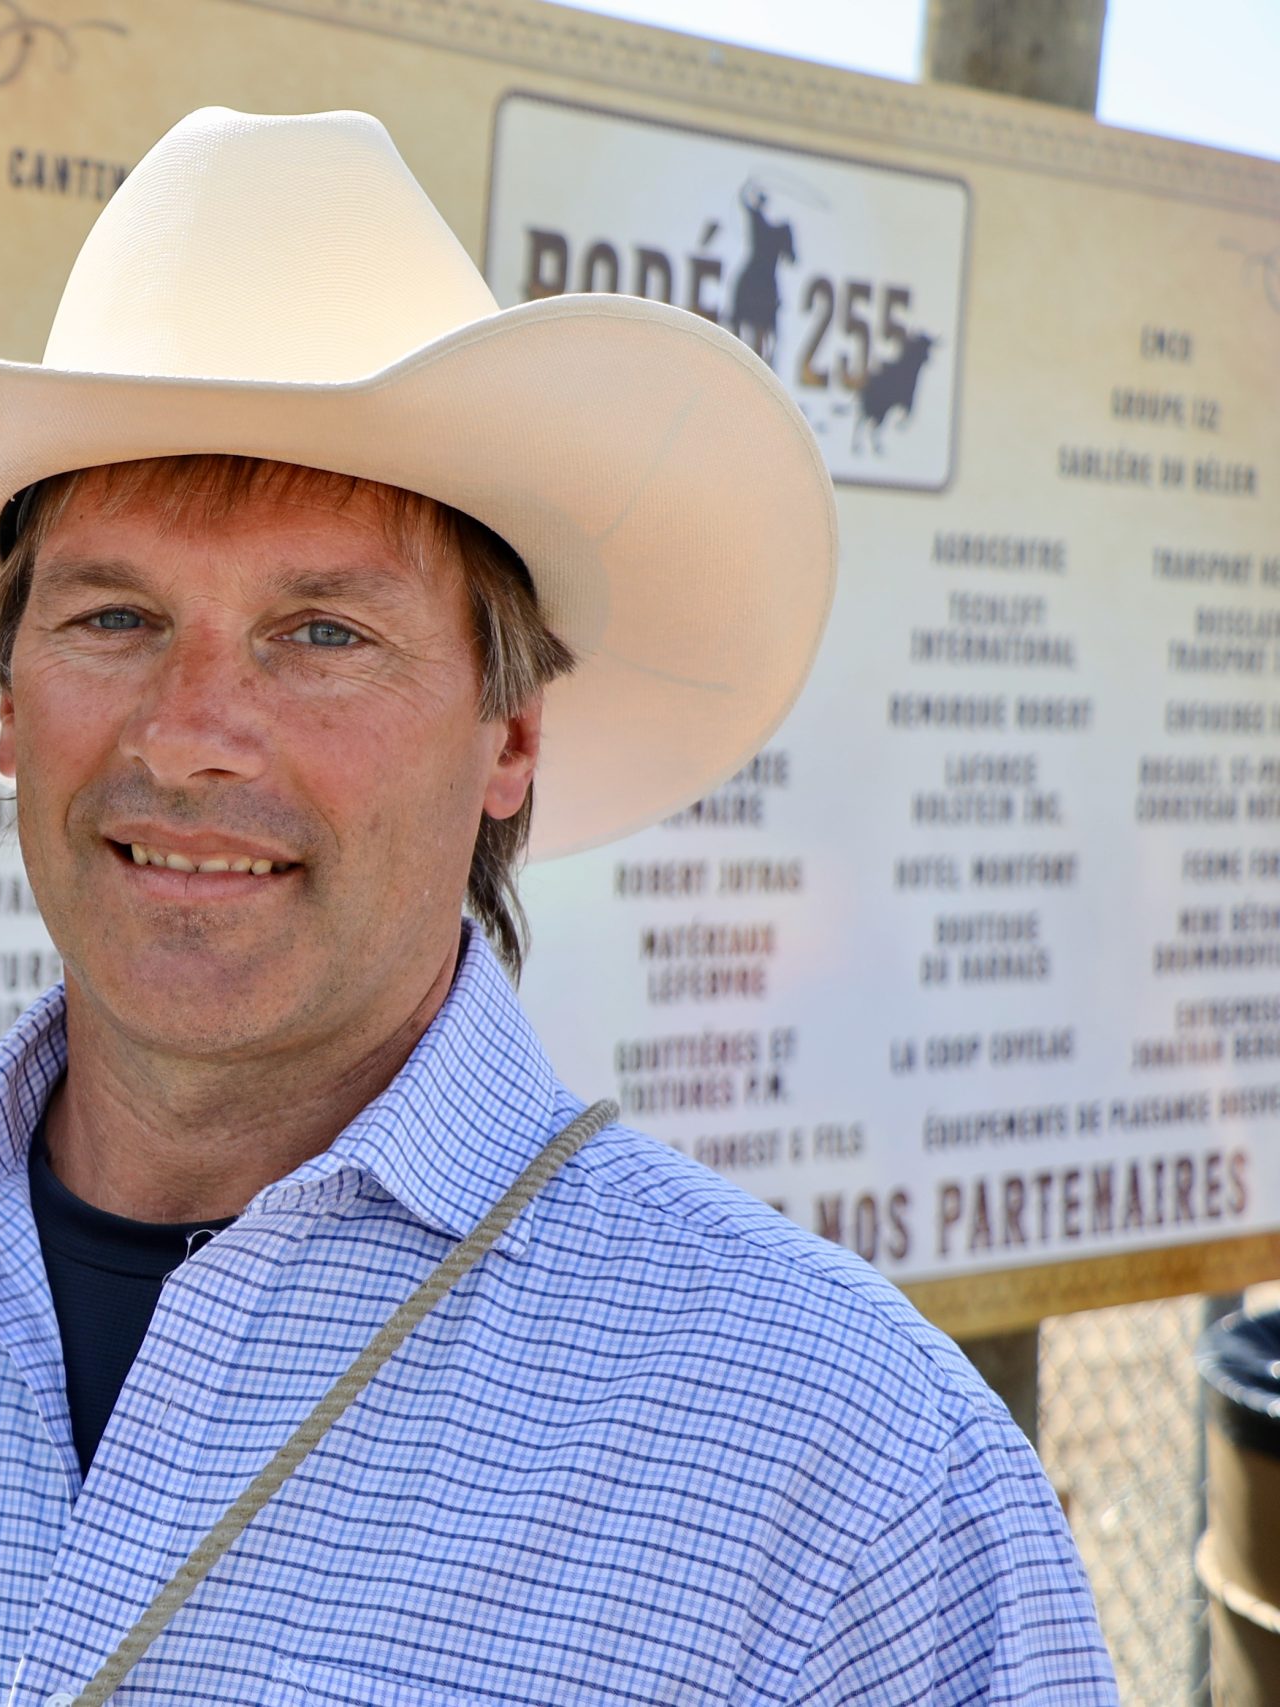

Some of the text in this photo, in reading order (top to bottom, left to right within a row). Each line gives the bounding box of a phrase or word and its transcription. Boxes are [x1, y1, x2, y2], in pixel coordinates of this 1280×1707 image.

[799, 276, 912, 388] 255
[930, 532, 1067, 576] AGROCENTRE
[1152, 547, 1257, 588] TRANSPORT
[910, 627, 1077, 669] INTERNATIONAL
[1168, 638, 1266, 676] TRANSPORT
[887, 692, 1094, 732] REMORQUE ROBERT
[944, 753, 1039, 788] LAFORCE
[615, 860, 708, 898] ROBERT
[971, 853, 1079, 888] MONTFORT
[639, 918, 776, 961] MATÉRIAUX
[934, 909, 1042, 945] BOUTIQUE
[647, 964, 767, 1004] LEFEBVRE
[920, 949, 951, 988] DU
[768, 1026, 798, 1067] ET
[889, 1040, 919, 1076] LA
[924, 1034, 983, 1072] COOP
[923, 1106, 1068, 1151] ÉQUIPEMENTS
[1075, 1101, 1103, 1135] DE
[1108, 1093, 1211, 1132] PLAISANCE
[690, 1132, 782, 1172] FOREST
[812, 1121, 867, 1161] FILS
[814, 1150, 1248, 1264] NOS PARTENAIRES
